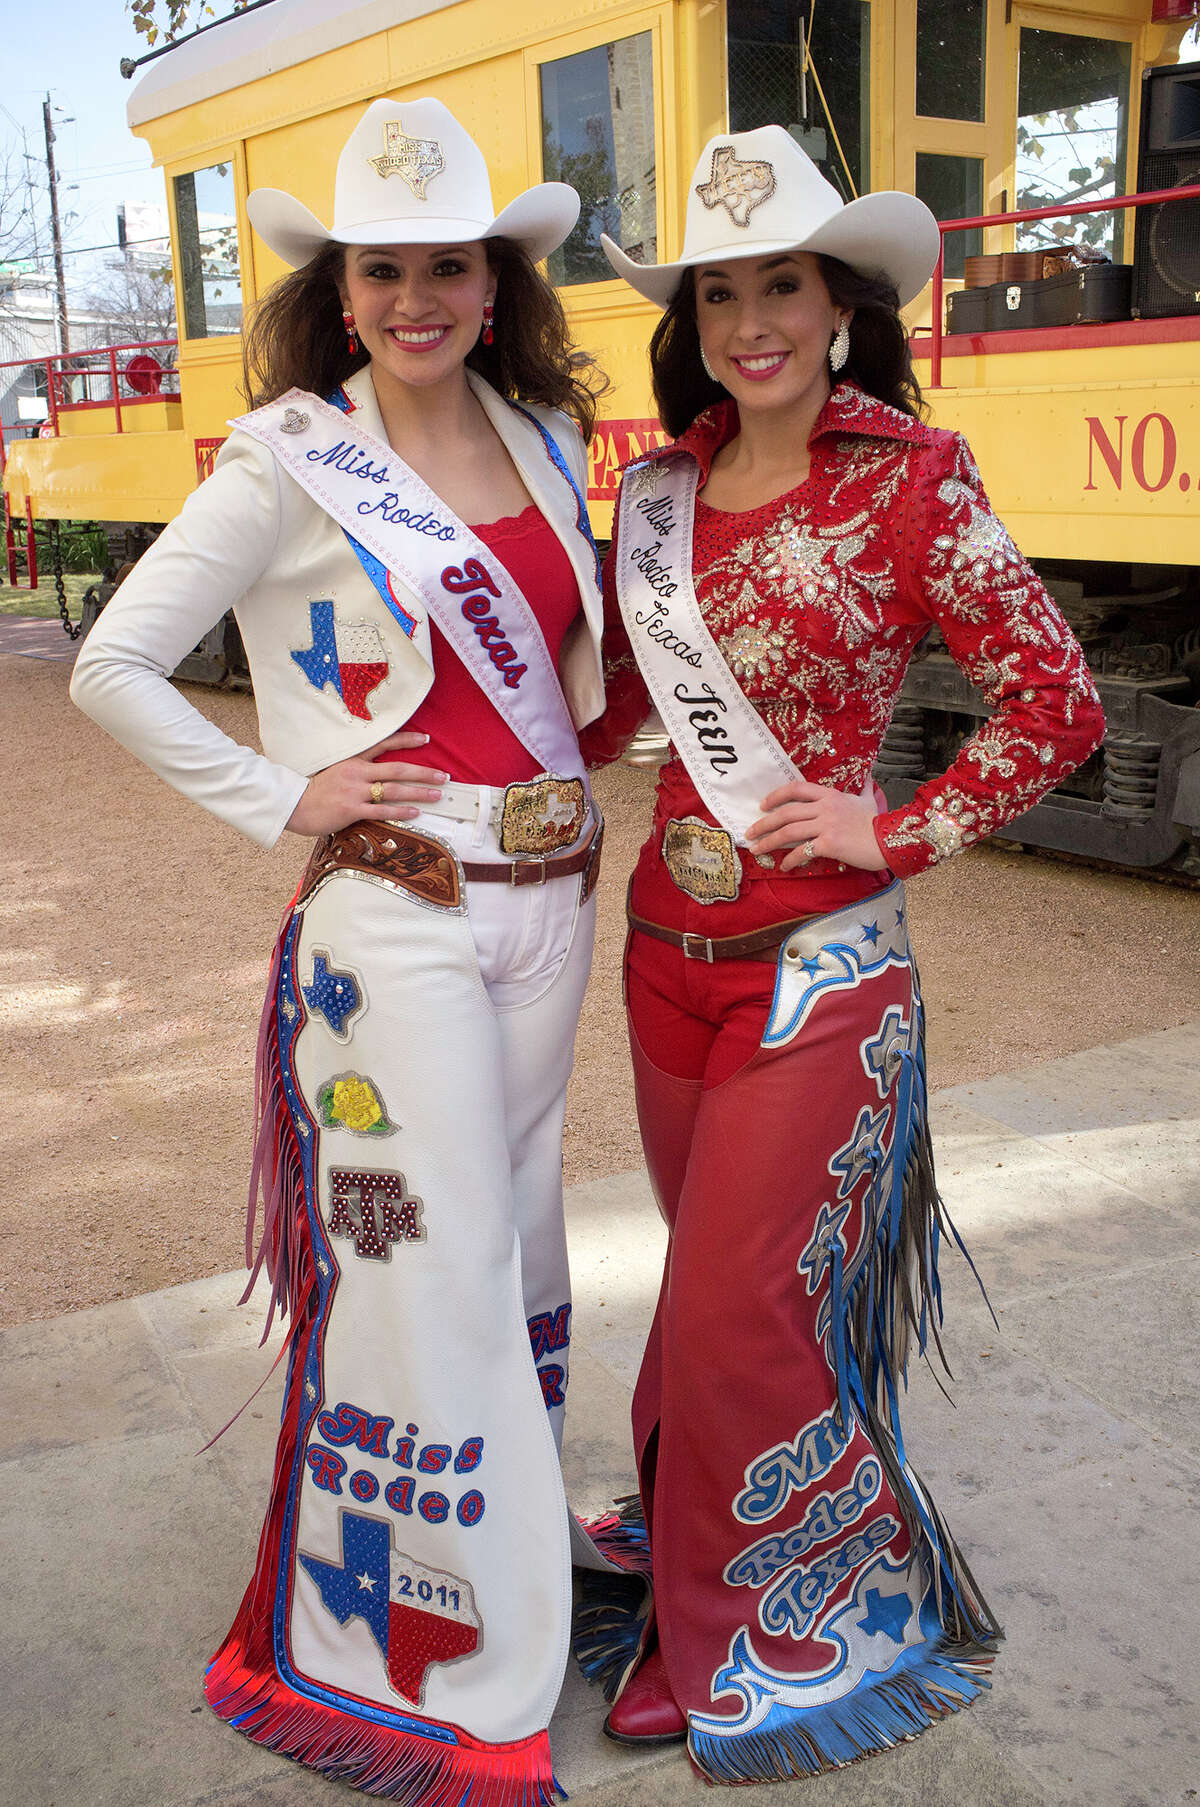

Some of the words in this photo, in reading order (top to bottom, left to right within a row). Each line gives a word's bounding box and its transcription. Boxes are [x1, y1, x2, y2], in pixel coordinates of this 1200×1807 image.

[399, 142, 422, 153] MISS
[1083, 412, 1191, 492] NO.
[636, 495, 678, 537] Miss
[306, 440, 389, 484] Miss
[357, 492, 456, 542] Rodeo
[440, 557, 529, 690] Texas
[630, 540, 678, 598] Rodeo
[635, 600, 703, 669] Texas
[317, 1402, 484, 1475] Miss
[734, 1400, 855, 1523] Mi
[306, 1443, 486, 1527] Rodeo
[724, 1456, 882, 1587] Rodeo
[398, 1575, 460, 1611] 2011
[760, 1515, 899, 1639] Texas
